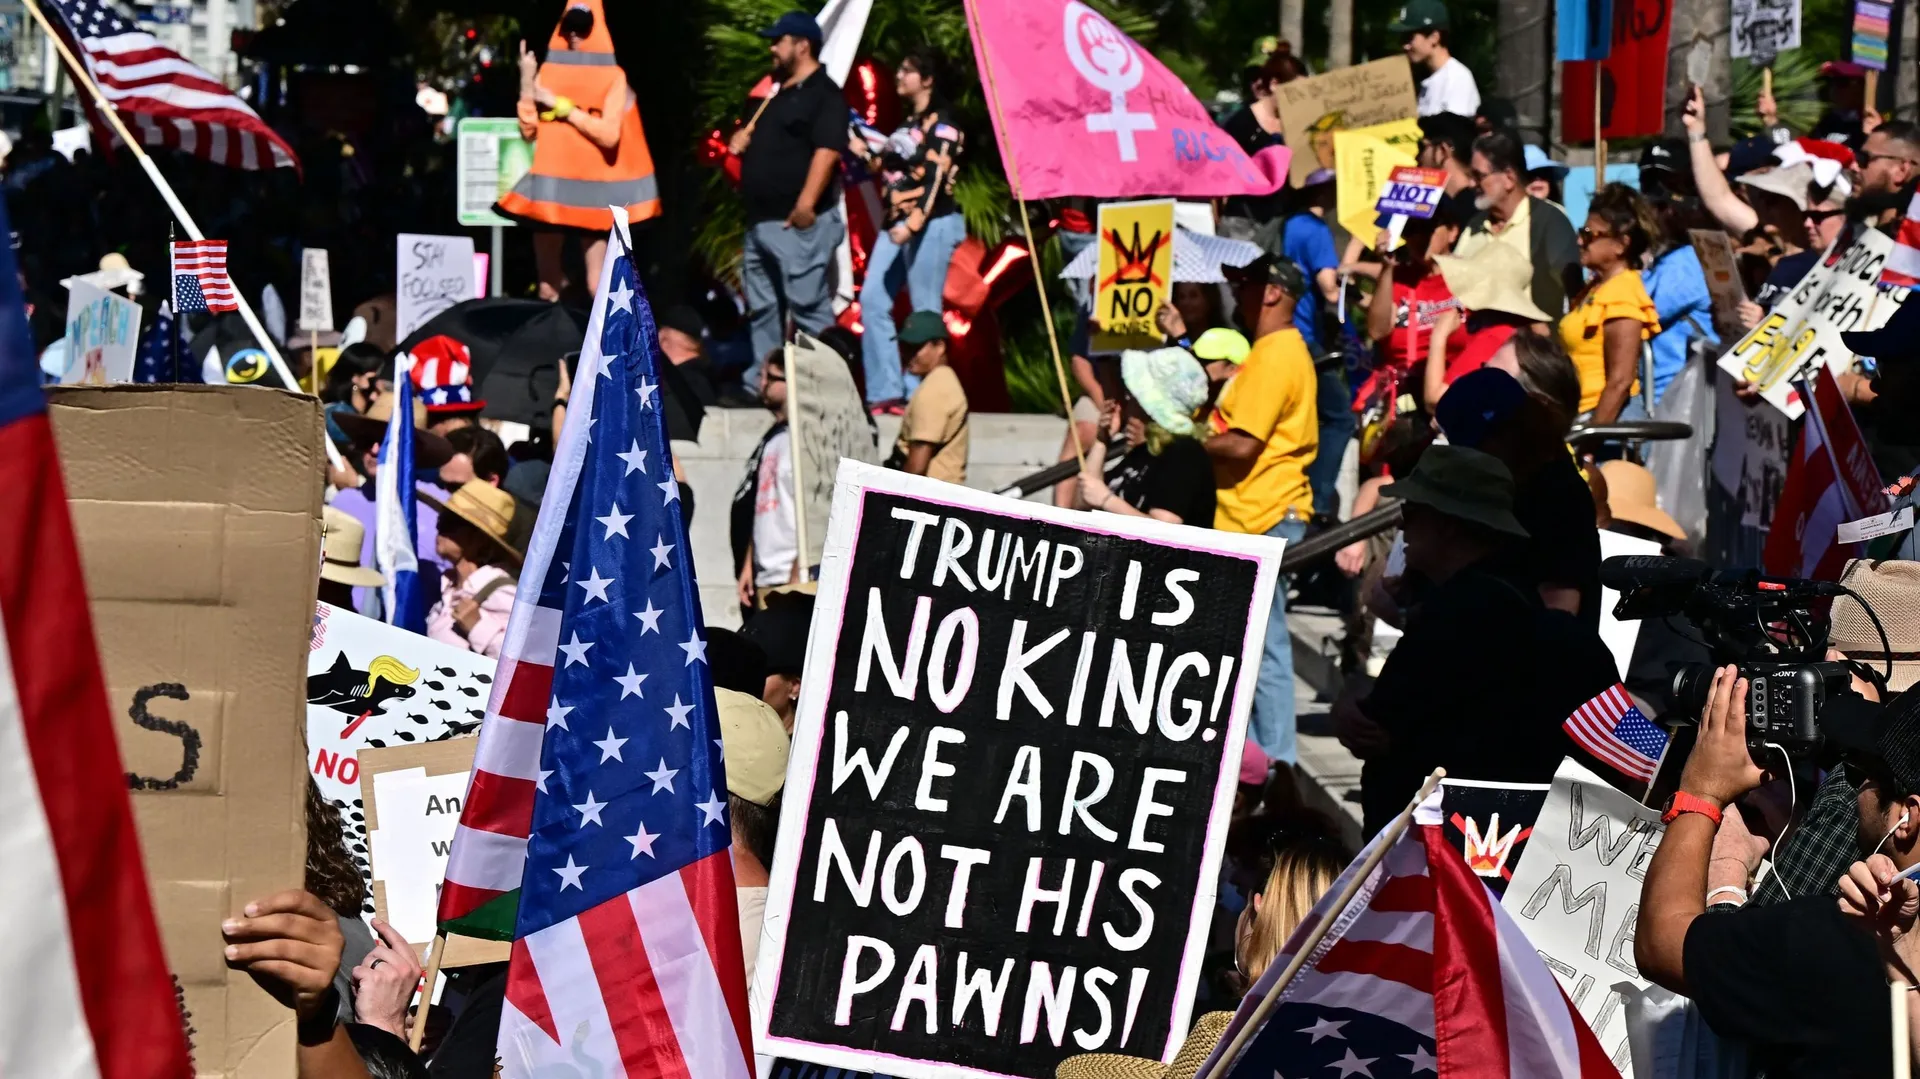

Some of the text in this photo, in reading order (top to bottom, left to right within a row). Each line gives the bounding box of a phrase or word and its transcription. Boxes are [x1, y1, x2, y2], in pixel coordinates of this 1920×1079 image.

[1389, 183, 1435, 204] NOT
[1111, 287, 1153, 319] NO
[1812, 283, 1863, 331] orth
[891, 507, 1200, 626] TRUMP IS
[854, 587, 1234, 742] NO KING!
[314, 748, 359, 785] NO
[832, 711, 1186, 853] WE ARE
[814, 818, 1161, 951] NOT HIS
[835, 935, 1149, 1050] PAWNS!
